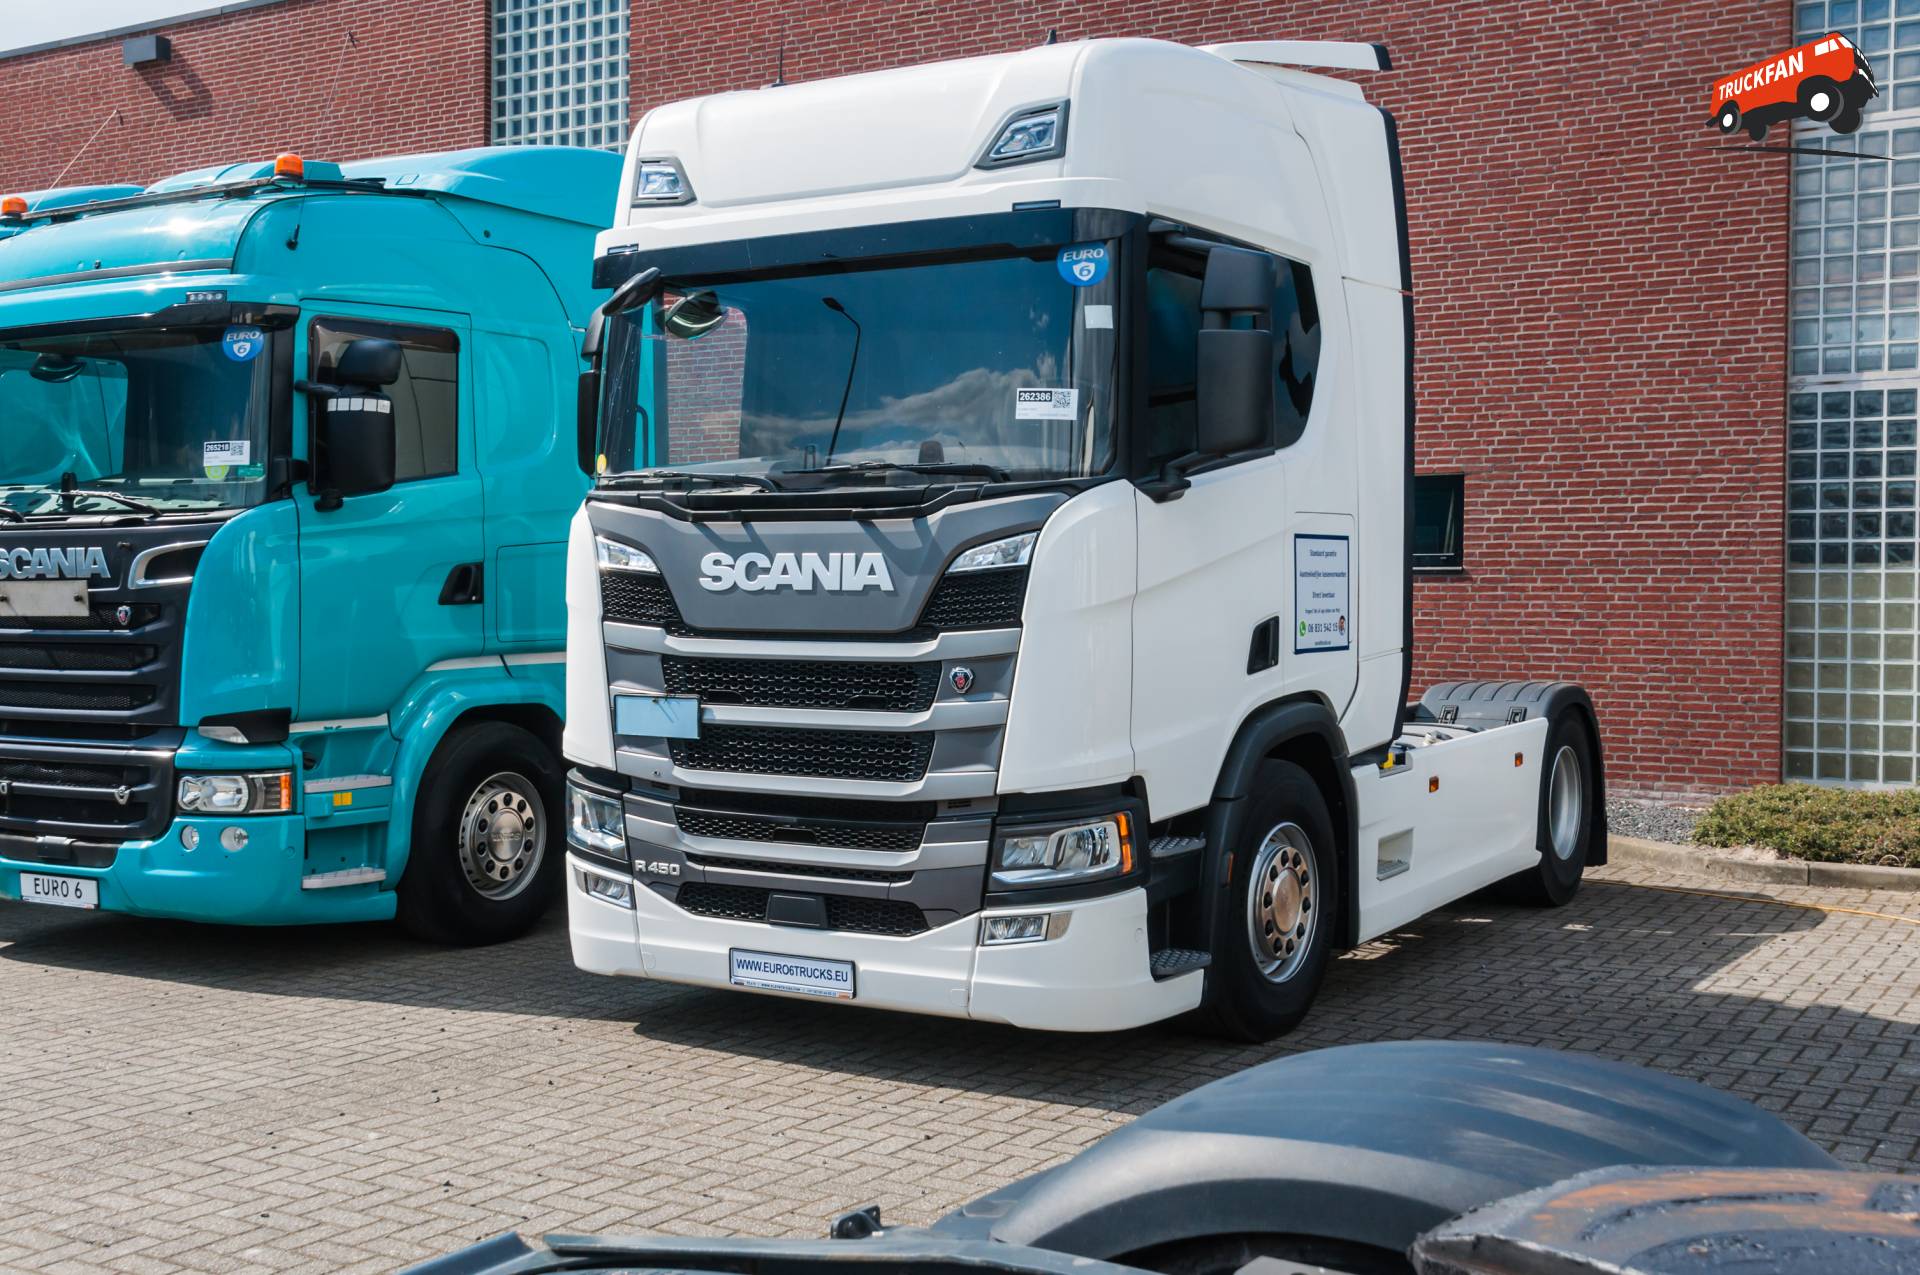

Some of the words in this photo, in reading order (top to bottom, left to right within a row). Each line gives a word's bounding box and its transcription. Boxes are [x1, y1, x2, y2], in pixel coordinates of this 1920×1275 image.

[1062, 248, 1105, 263] EURO
[226, 331, 261, 342] EURO
[1019, 391, 1052, 401] 262386
[699, 552, 895, 592] SCANIA
[635, 860, 646, 872] R
[648, 862, 680, 876] 450
[34, 878, 69, 898] EURO
[75, 881, 83, 899] 6
[736, 959, 848, 982] WWW.EURO6TRUCKS.EU
